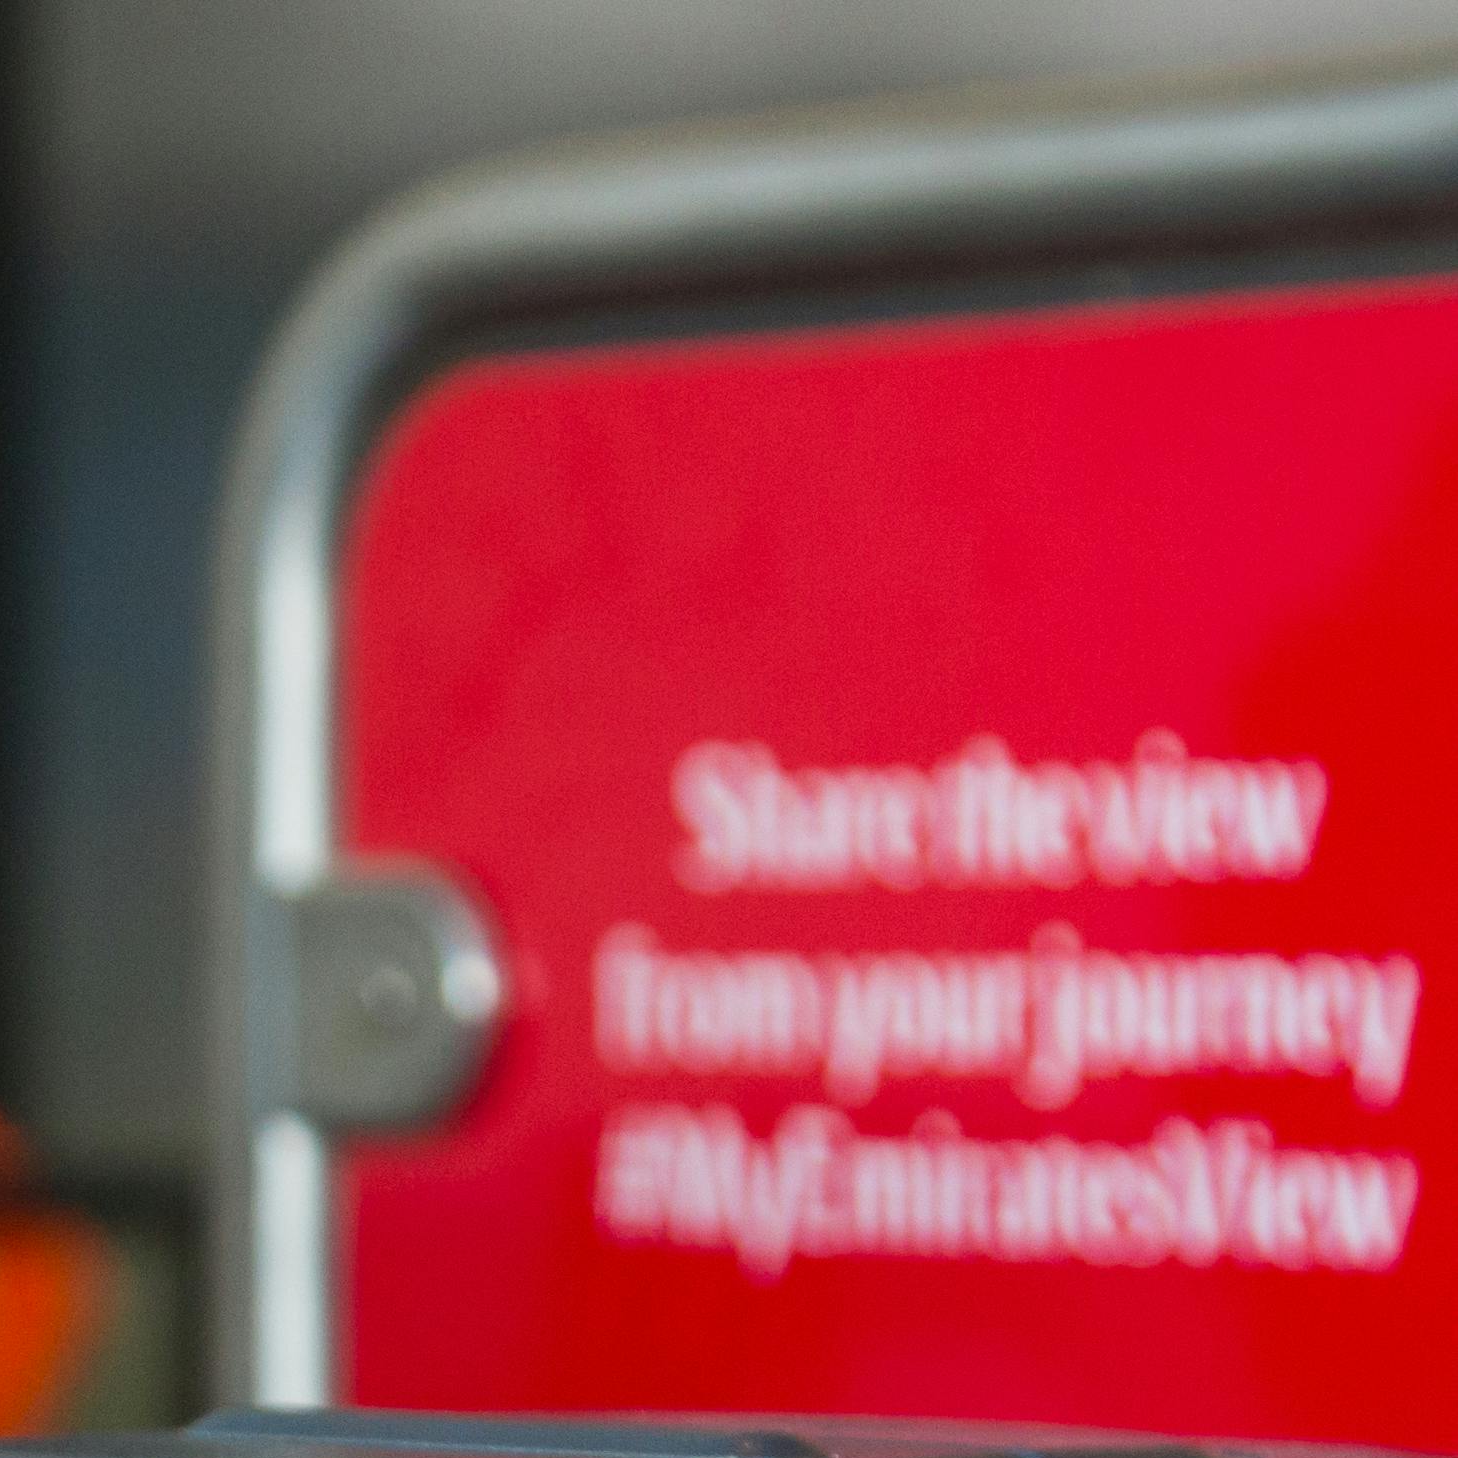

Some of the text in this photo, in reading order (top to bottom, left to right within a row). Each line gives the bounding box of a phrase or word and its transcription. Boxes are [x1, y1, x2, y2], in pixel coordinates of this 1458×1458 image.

[676, 730, 1326, 890] Share the view
[598, 923, 1420, 1108] from your journey
[597, 1104, 1417, 1284] #MyEmiratesView
